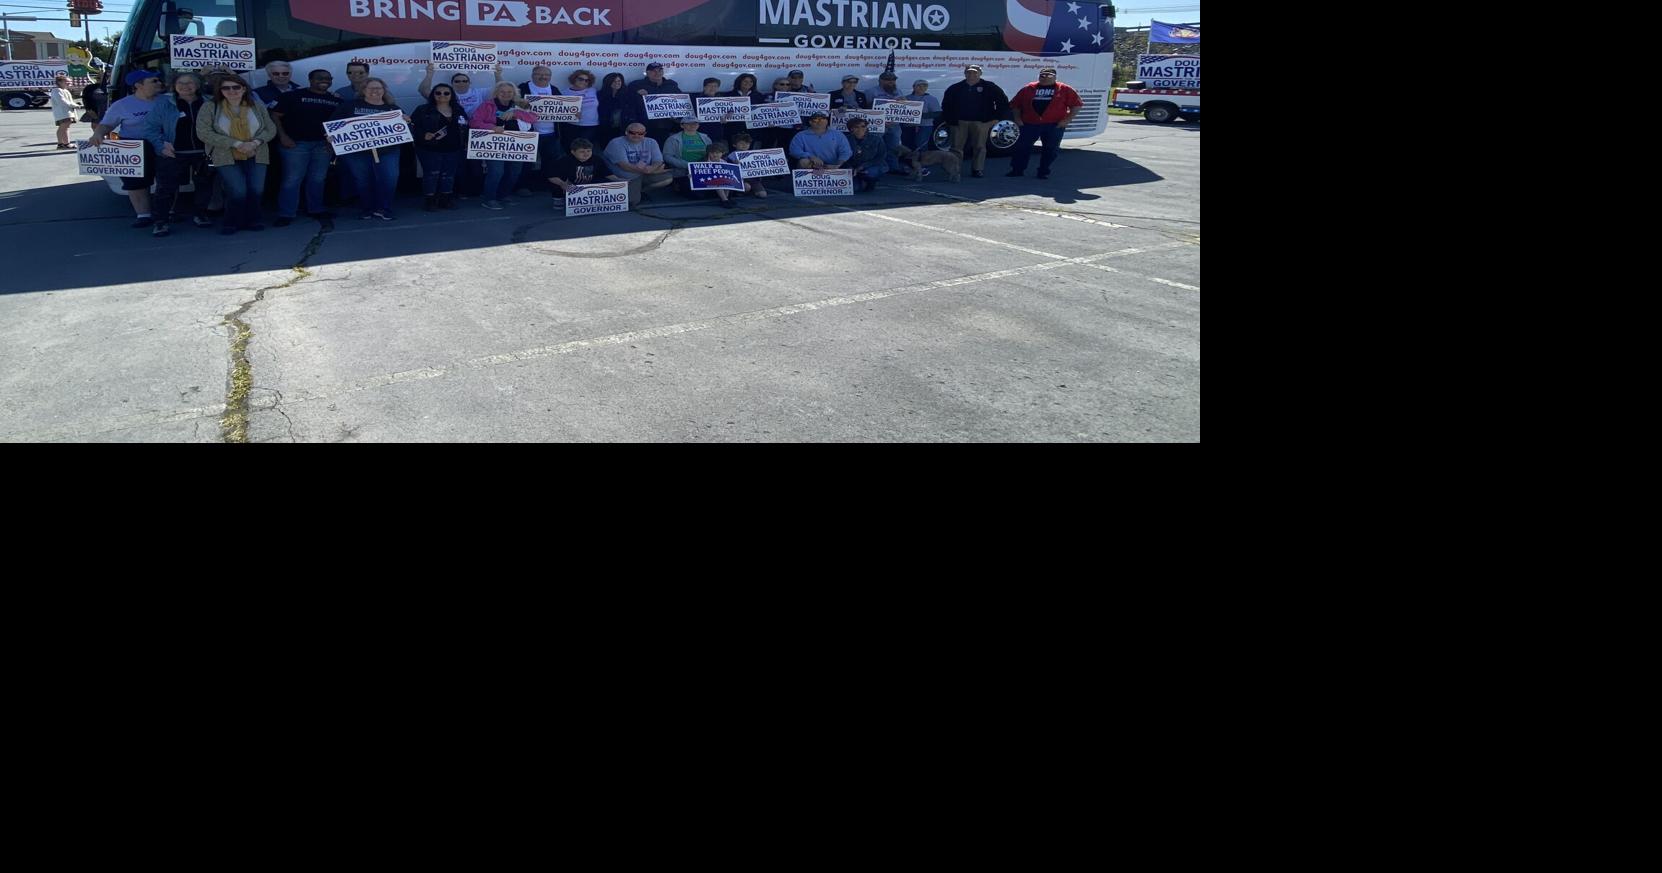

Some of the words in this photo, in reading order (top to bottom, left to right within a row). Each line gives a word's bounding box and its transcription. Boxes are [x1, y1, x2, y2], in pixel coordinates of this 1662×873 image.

[350, 0, 460, 20] BRING
[478, 2, 516, 21] PA
[535, 6, 612, 26] BACK
[759, 0, 950, 31] MASTRIANO
[794, 34, 912, 49] GOVERNOR
[173, 48, 253, 59] MASTRIANO
[433, 52, 496, 62] MASTRIANO
[351, 56, 430, 65] doug4gov.com
[647, 103, 692, 111] MASTRIANO
[699, 105, 749, 115] MASTRIANO
[353, 121, 380, 130] DOUG
[331, 123, 406, 144] MASTRIANO
[343, 135, 404, 152] GOVERNOR
[470, 141, 535, 152] MASTRIANO
[80, 154, 141, 165] MASTRIANO
[476, 152, 528, 160] GOVERNOR
[741, 158, 786, 169] MASTRIANO
[87, 167, 135, 175] GOVERNOR
[747, 168, 785, 177] GOVERNOR
[795, 179, 848, 188] MASTRIANO
[568, 193, 626, 206] MASTRIANO
[573, 205, 621, 214] GOVERNOR
